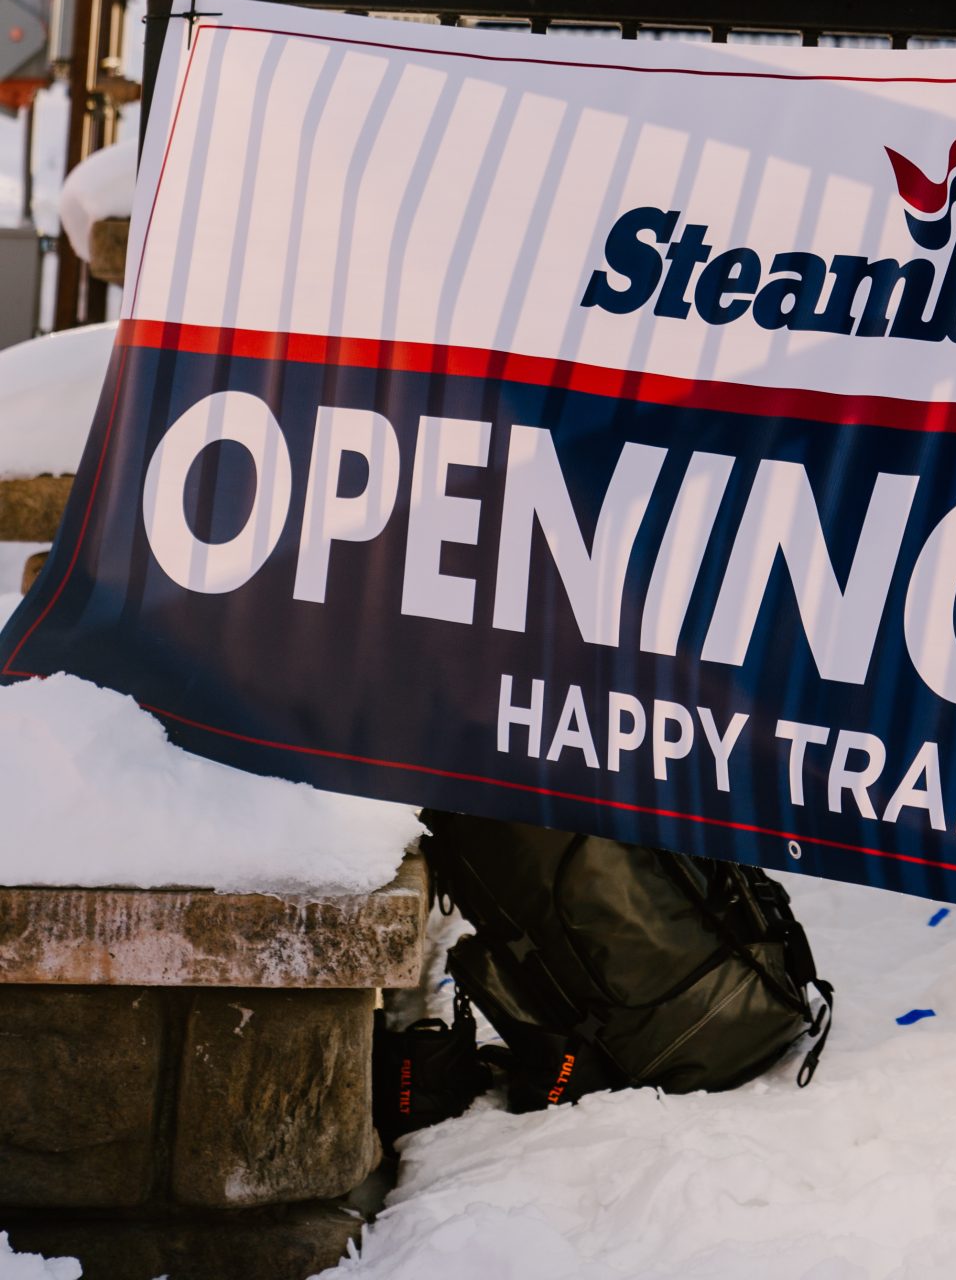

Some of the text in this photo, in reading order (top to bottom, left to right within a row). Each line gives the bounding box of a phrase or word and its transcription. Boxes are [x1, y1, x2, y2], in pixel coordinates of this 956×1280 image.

[496, 674, 750, 793] HAPPY
[399, 1089, 411, 1114] TILT
[547, 1053, 576, 1105] FULL TLT
